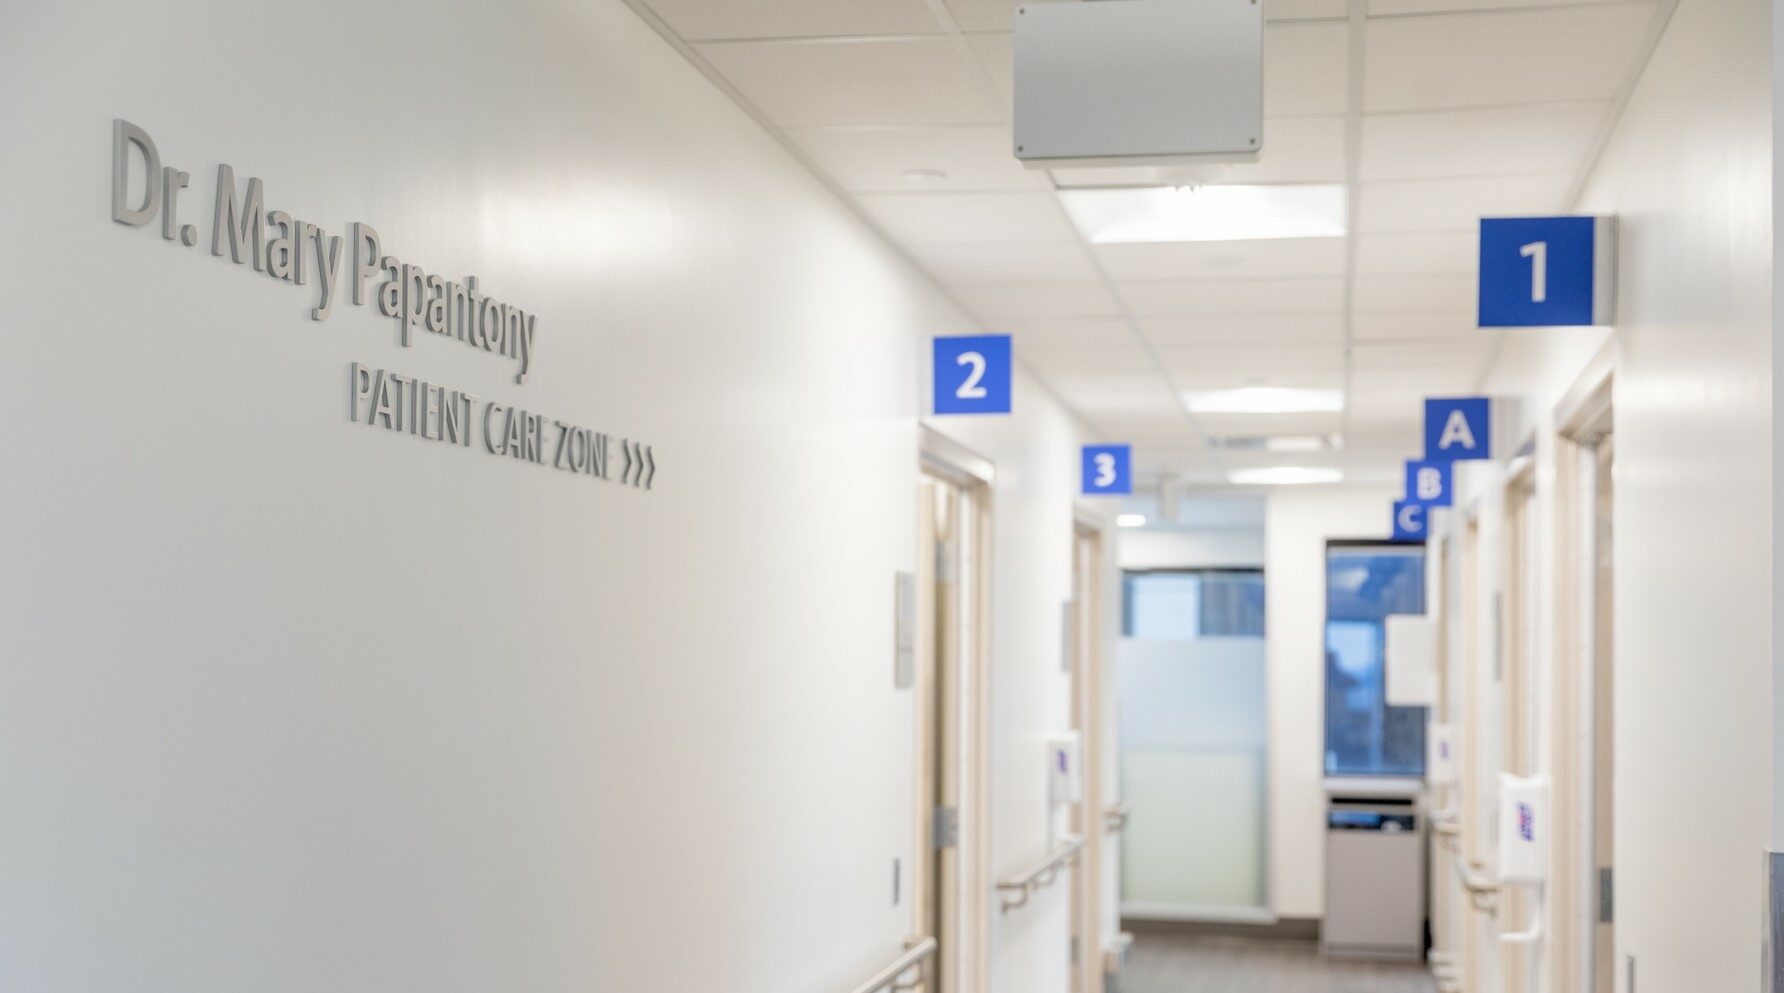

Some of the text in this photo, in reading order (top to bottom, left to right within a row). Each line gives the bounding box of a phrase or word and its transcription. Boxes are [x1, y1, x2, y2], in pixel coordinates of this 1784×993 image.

[112, 118, 538, 384] Dr. Mary Papantony
[1519, 241, 1547, 303] 1
[956, 351, 988, 399] 2
[351, 362, 613, 480] PATIENT CARE ZONE
[1439, 409, 1476, 450] A
[1094, 453, 1117, 487] 3
[1416, 467, 1442, 497] B
[1397, 505, 1423, 532] C
